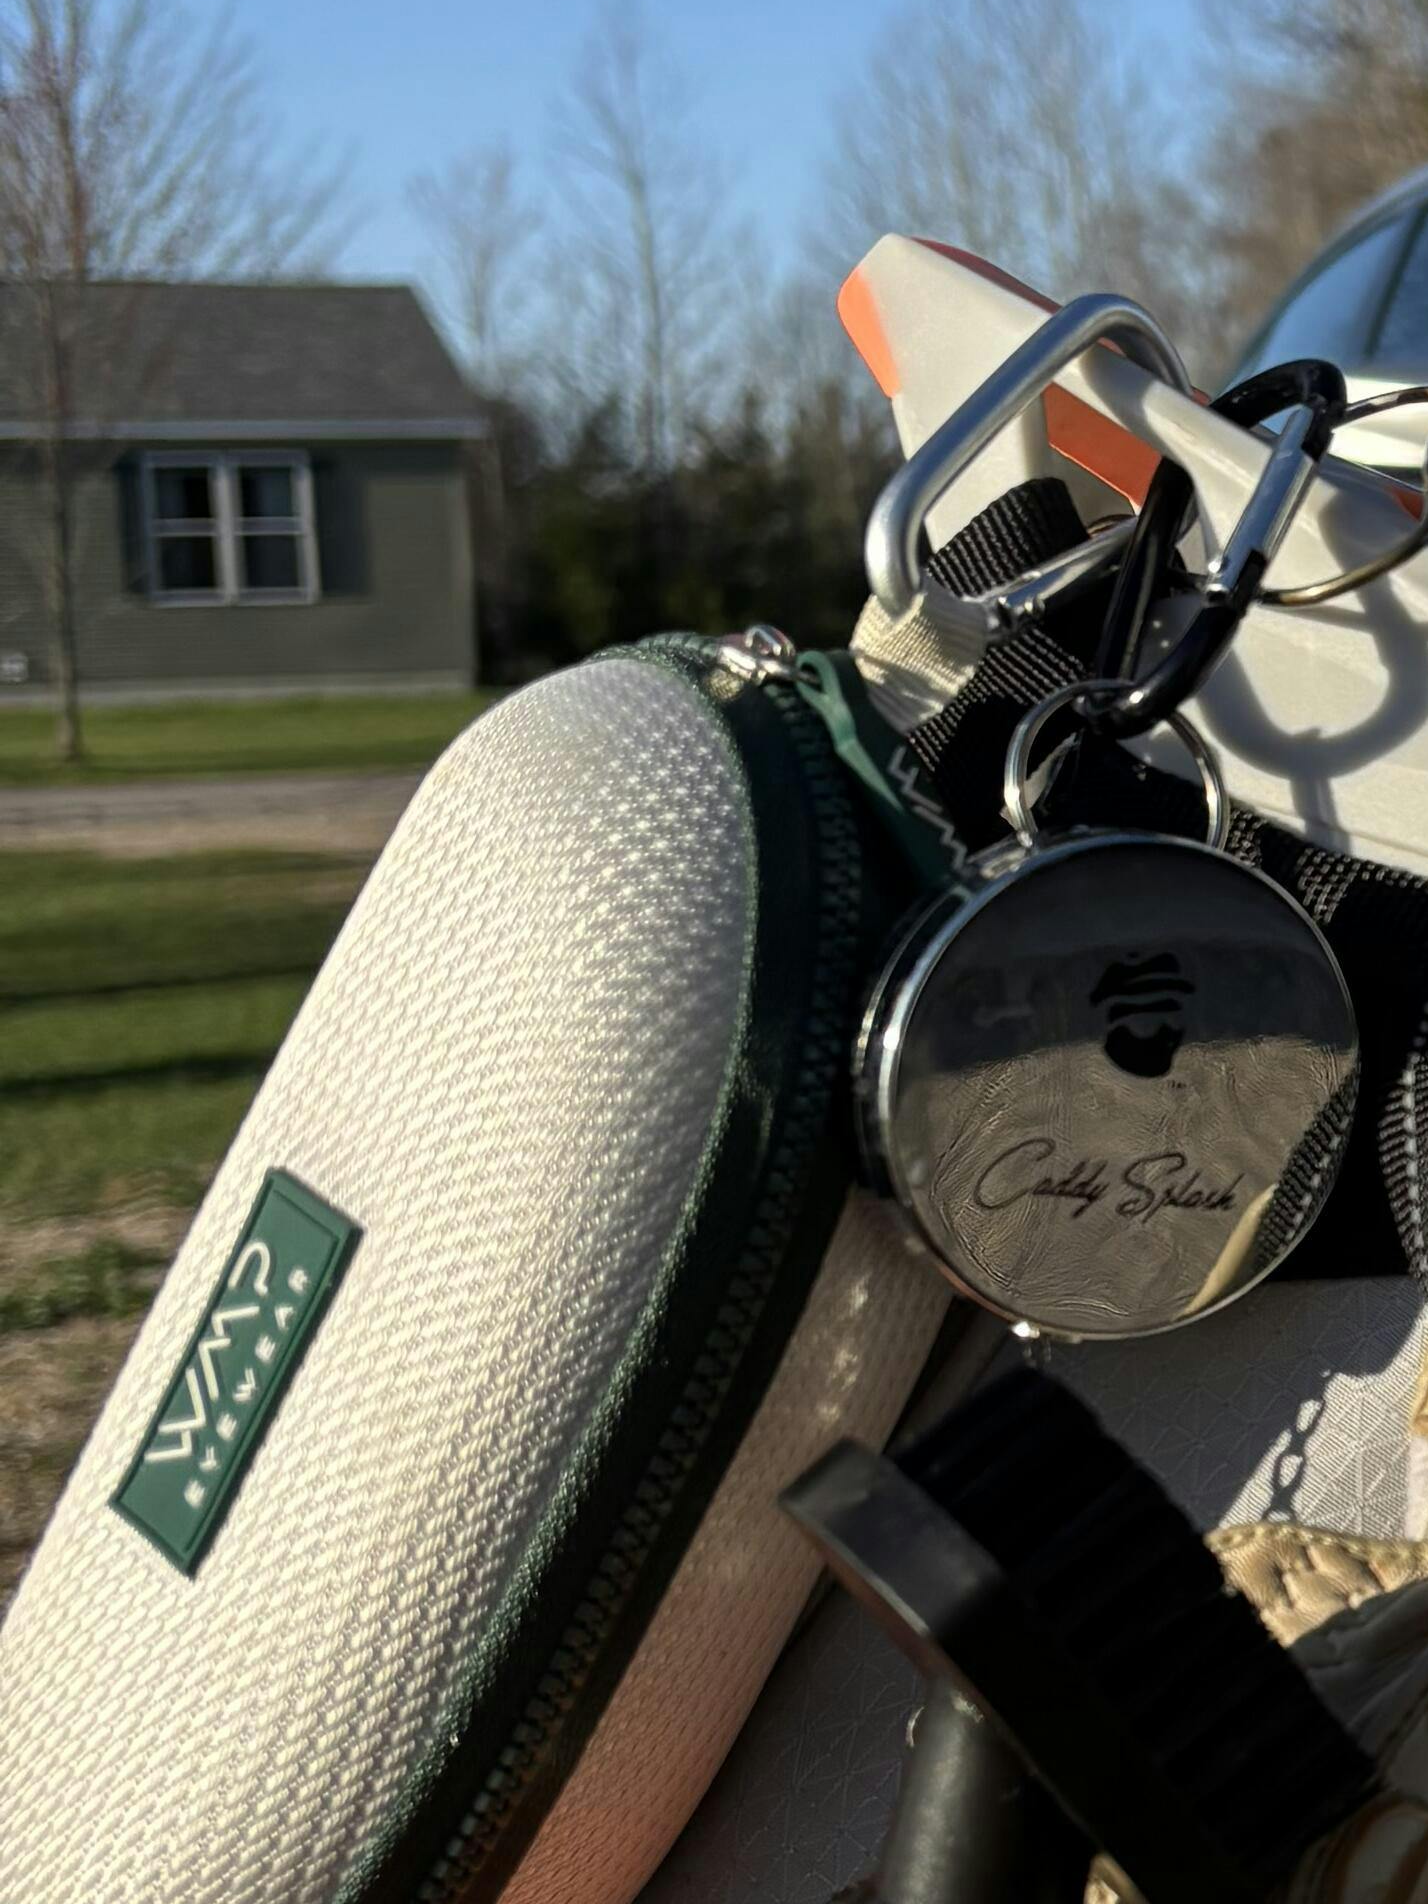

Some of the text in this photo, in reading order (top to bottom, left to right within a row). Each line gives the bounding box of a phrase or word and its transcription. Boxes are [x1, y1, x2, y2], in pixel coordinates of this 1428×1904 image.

[973, 1137, 1245, 1224] Caddy Splash
[183, 1268, 310, 1509] EYEWEAR
